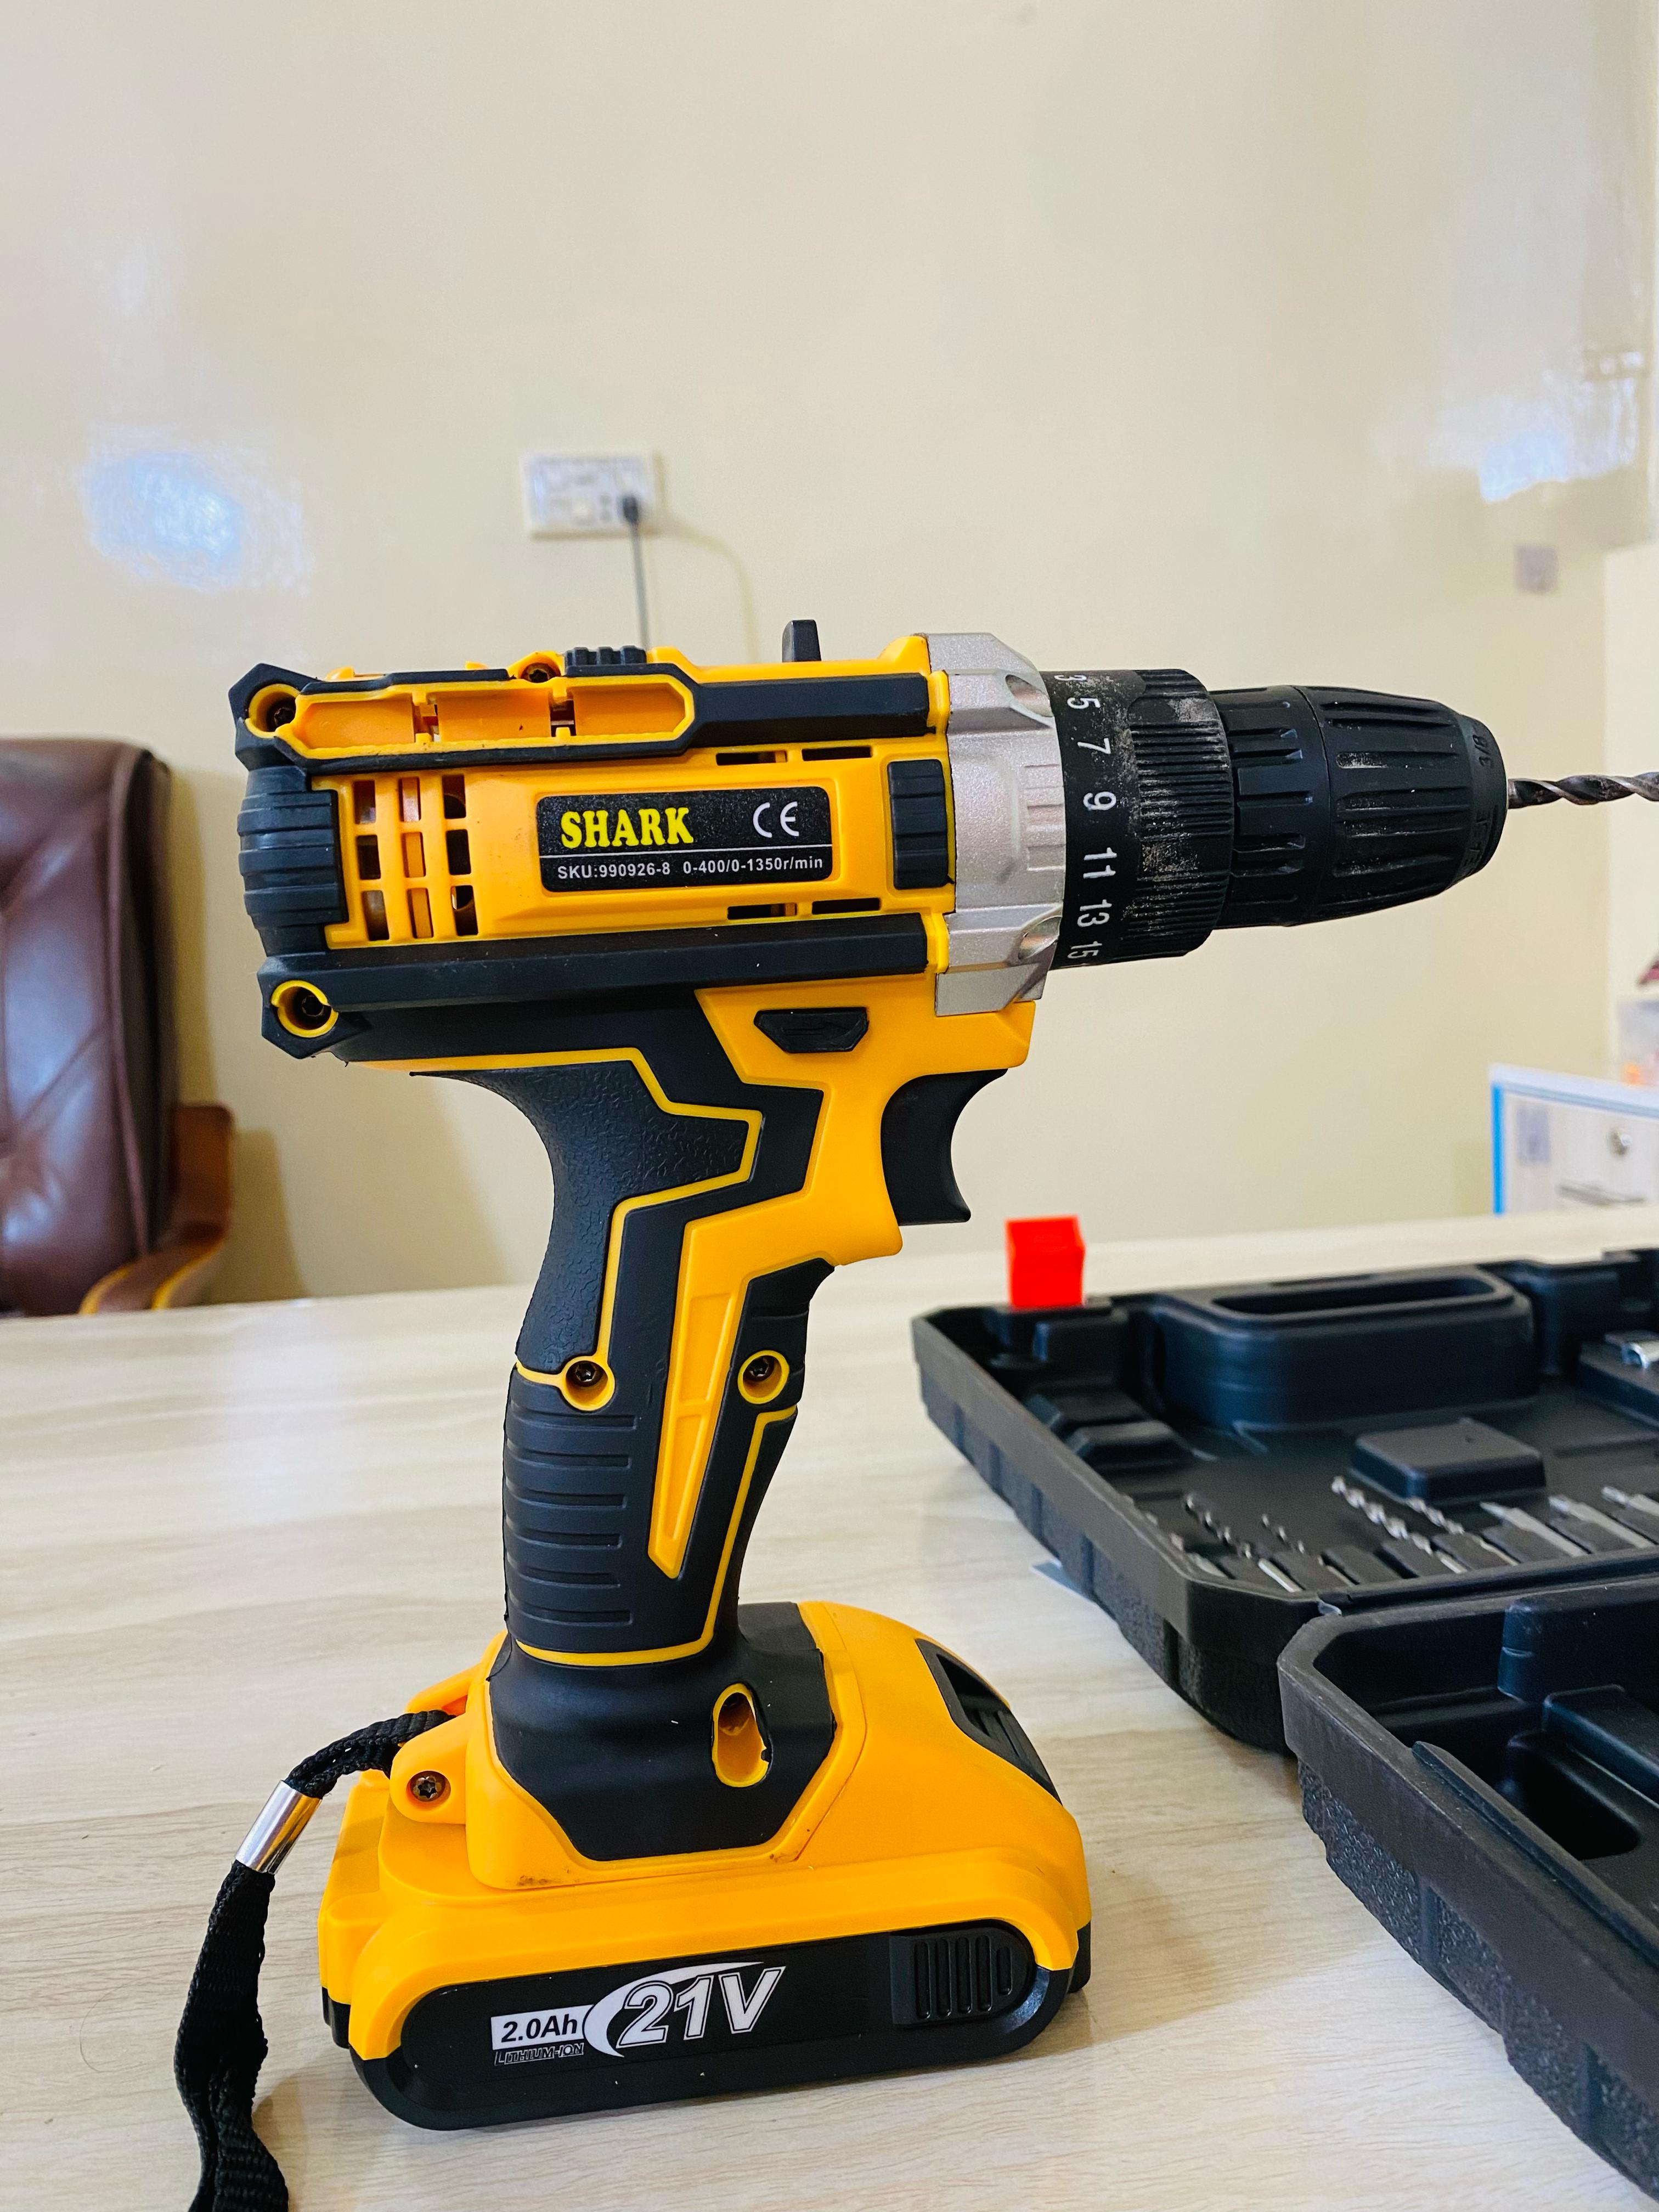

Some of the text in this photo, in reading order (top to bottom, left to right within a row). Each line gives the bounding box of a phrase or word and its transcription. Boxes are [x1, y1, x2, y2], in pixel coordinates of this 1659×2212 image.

[1067, 697, 1101, 709] 5
[1077, 737, 1111, 755] 7
[1082, 791, 1117, 811] 9
[560, 807, 694, 849] SHARK
[753, 801, 799, 838] CE
[557, 856, 823, 879] SKU:990926-8 0-400/0-1350r/min
[1083, 847, 1117, 878] 11
[1076, 899, 1112, 927] 13
[1067, 940, 1102, 959] 15
[616, 1966, 786, 2049] 21V
[501, 2013, 578, 2043] 2.0Ah
[494, 2042, 584, 2066] LITHIUM-ION
